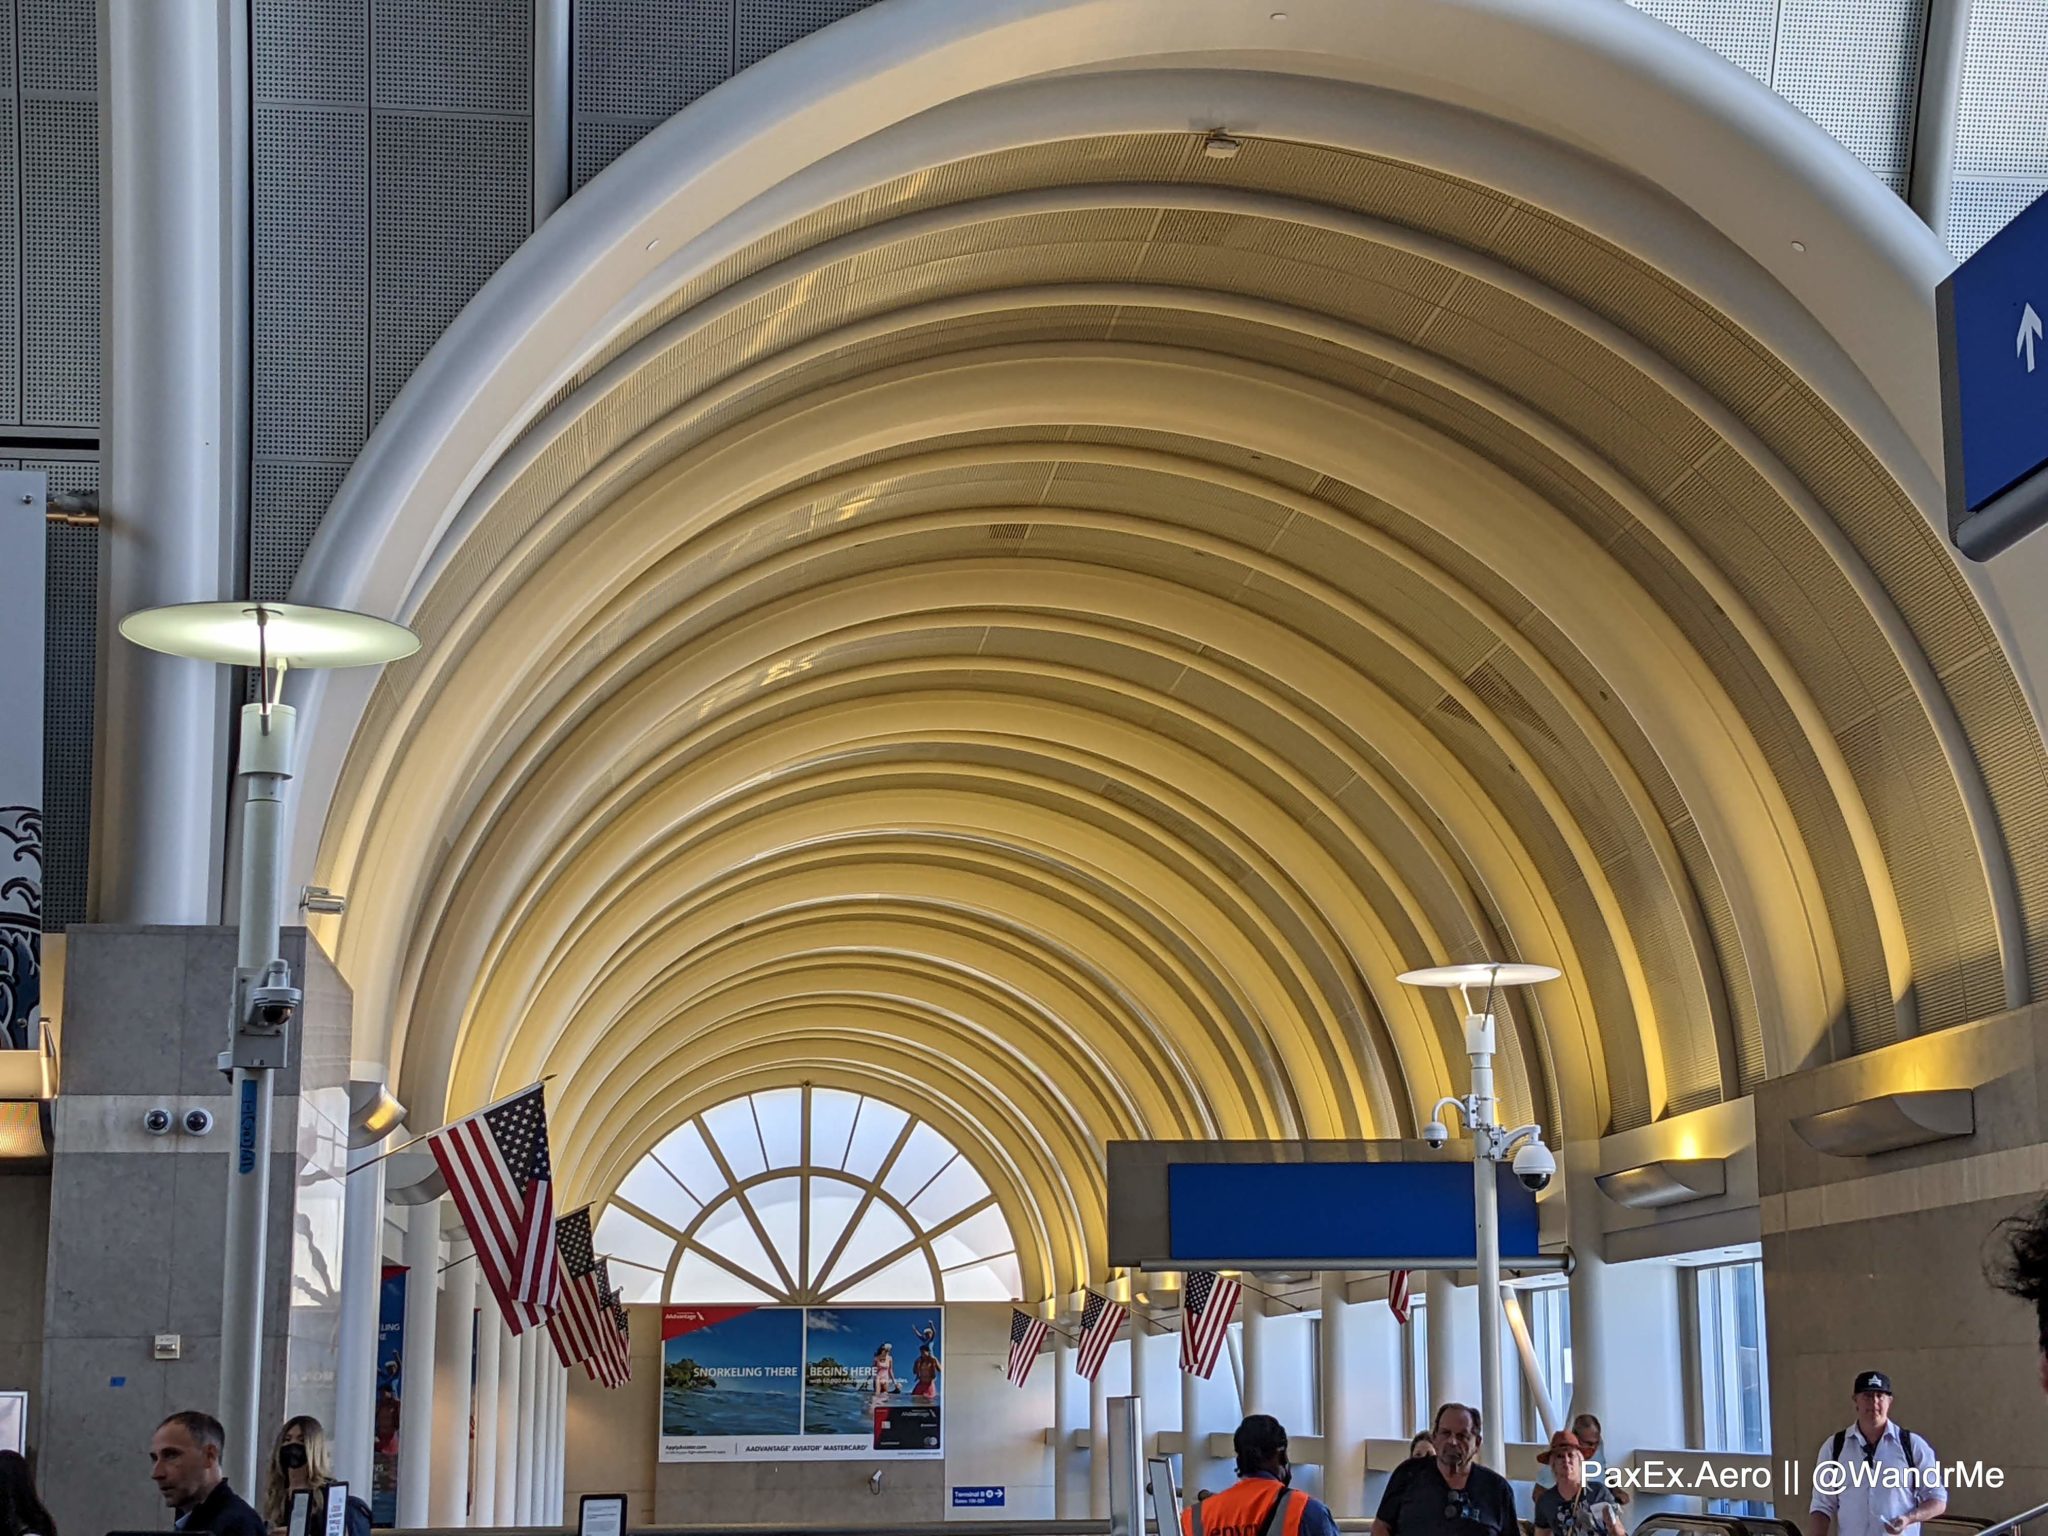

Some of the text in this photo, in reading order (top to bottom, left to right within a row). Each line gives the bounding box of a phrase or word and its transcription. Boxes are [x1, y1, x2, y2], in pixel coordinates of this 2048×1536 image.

[693, 1366, 798, 1378] SNORKELING THERE
[809, 1366, 878, 1377] BEGINS HERE
